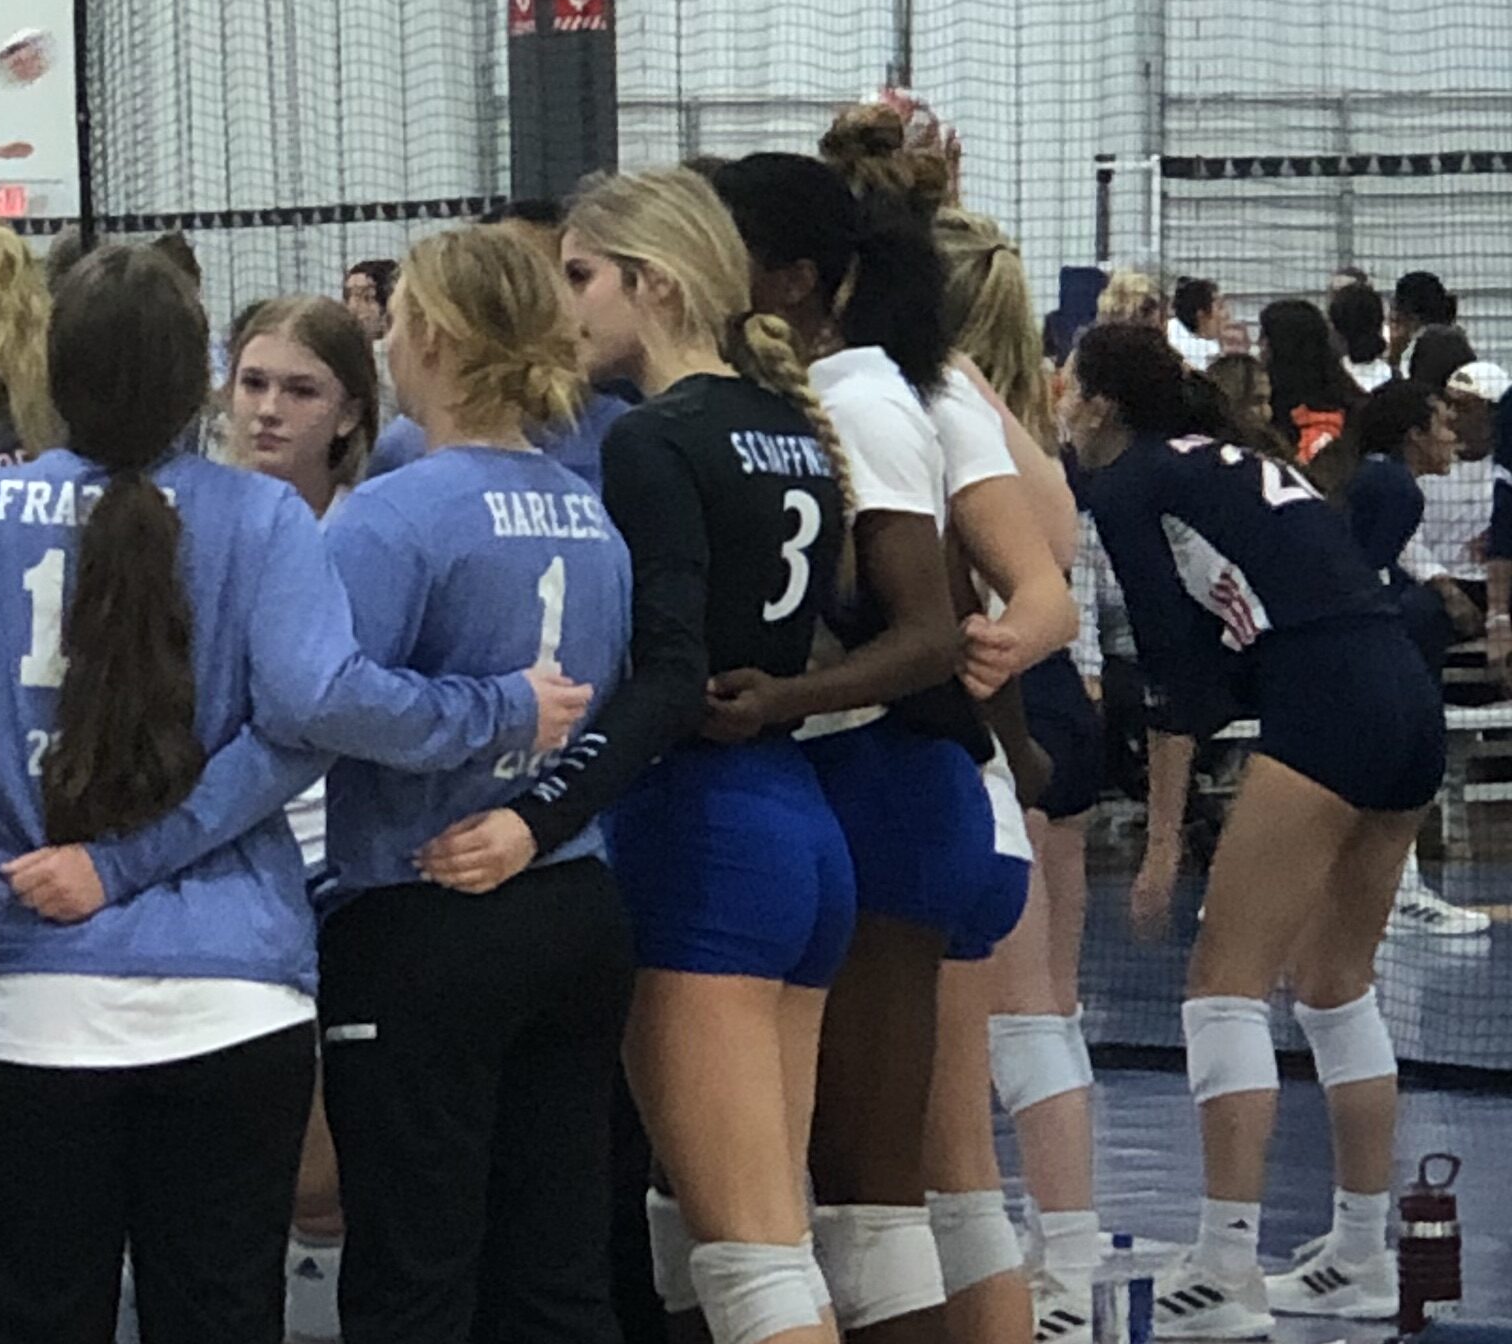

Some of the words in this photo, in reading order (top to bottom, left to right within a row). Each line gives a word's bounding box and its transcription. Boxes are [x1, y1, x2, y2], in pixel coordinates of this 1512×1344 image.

[20, 548, 72, 688] 1
[538, 555, 567, 680] 1
[762, 488, 822, 623] 3
